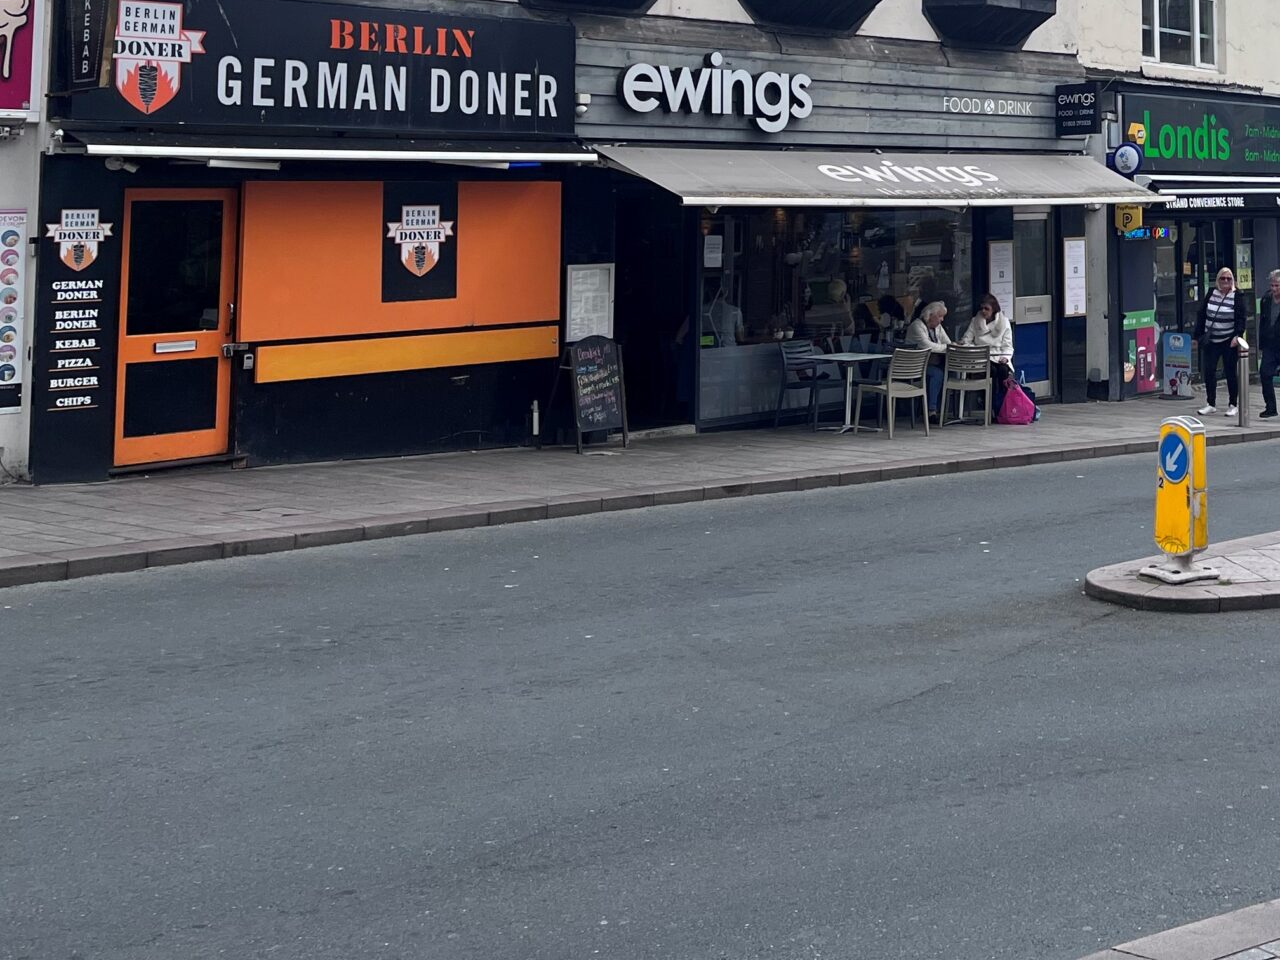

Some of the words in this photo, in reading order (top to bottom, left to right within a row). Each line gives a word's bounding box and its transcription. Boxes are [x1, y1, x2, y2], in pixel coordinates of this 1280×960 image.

[125, 6, 176, 20] BERLIN
[124, 21, 175, 34] GERMAN
[329, 18, 475, 58] BERLIN
[115, 39, 184, 58] DONER
[216, 55, 407, 111] GERMAN
[429, 67, 558, 118] DONER
[622, 50, 814, 133] ewings
[943, 96, 981, 113] FOOD
[998, 99, 1033, 115] DRINK
[1058, 92, 1095, 107] ewings
[1143, 110, 1231, 161] Londis
[817, 159, 1000, 187] ewings
[1188, 197, 1227, 209] CONVENIENCE
[1227, 196, 1245, 207] STORE
[58, 231, 100, 241] DONER
[399, 230, 441, 241] DONER
[52, 280, 103, 290] GERMAN
[57, 290, 98, 300] DONER
[55, 309, 98, 320] BERLIN
[55, 319, 97, 330] DONER
[55, 338, 96, 349] KEBAB
[57, 358, 93, 368] PIZZA
[50, 376, 98, 388] BURGER
[56, 396, 92, 406] CHIPS
[1158, 477, 1164, 489] 2
